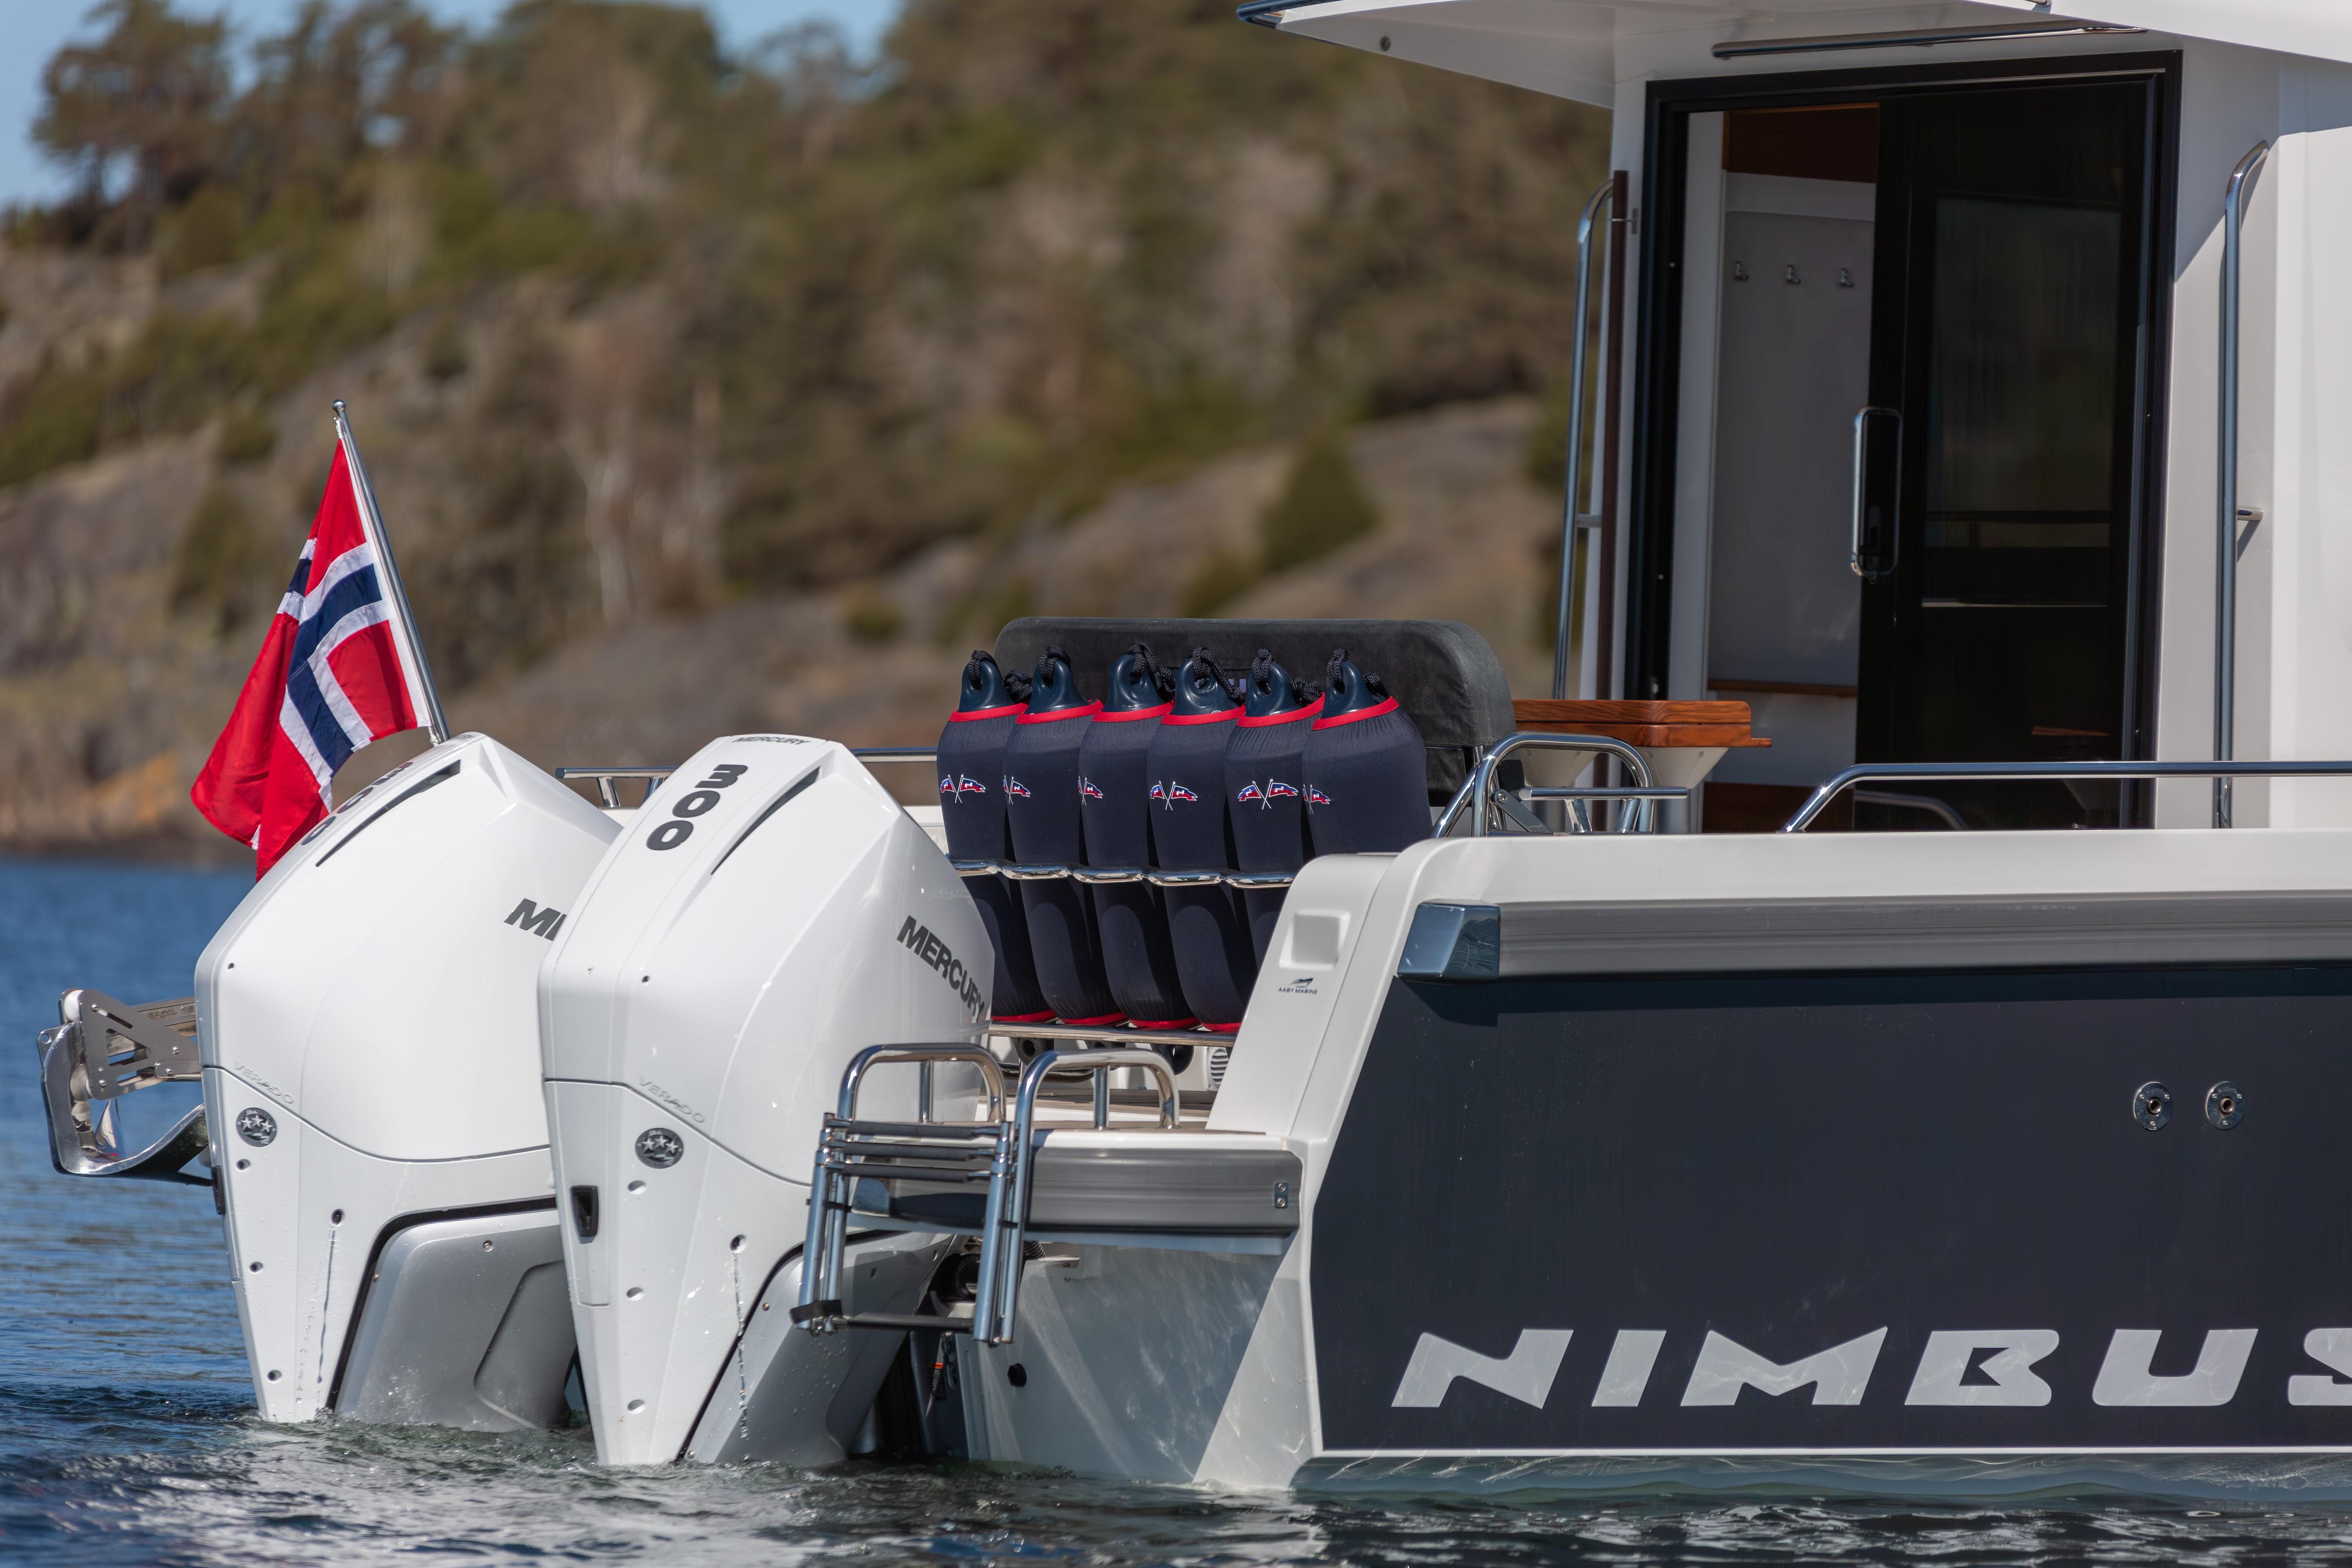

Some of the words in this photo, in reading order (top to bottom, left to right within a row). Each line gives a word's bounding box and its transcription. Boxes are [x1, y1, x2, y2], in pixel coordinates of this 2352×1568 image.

[731, 736, 811, 745] MERCURY
[646, 764, 748, 851] 300
[896, 915, 985, 1022] MERCURY
[234, 1059, 294, 1104] VERADO
[639, 1075, 705, 1123] VERADO
